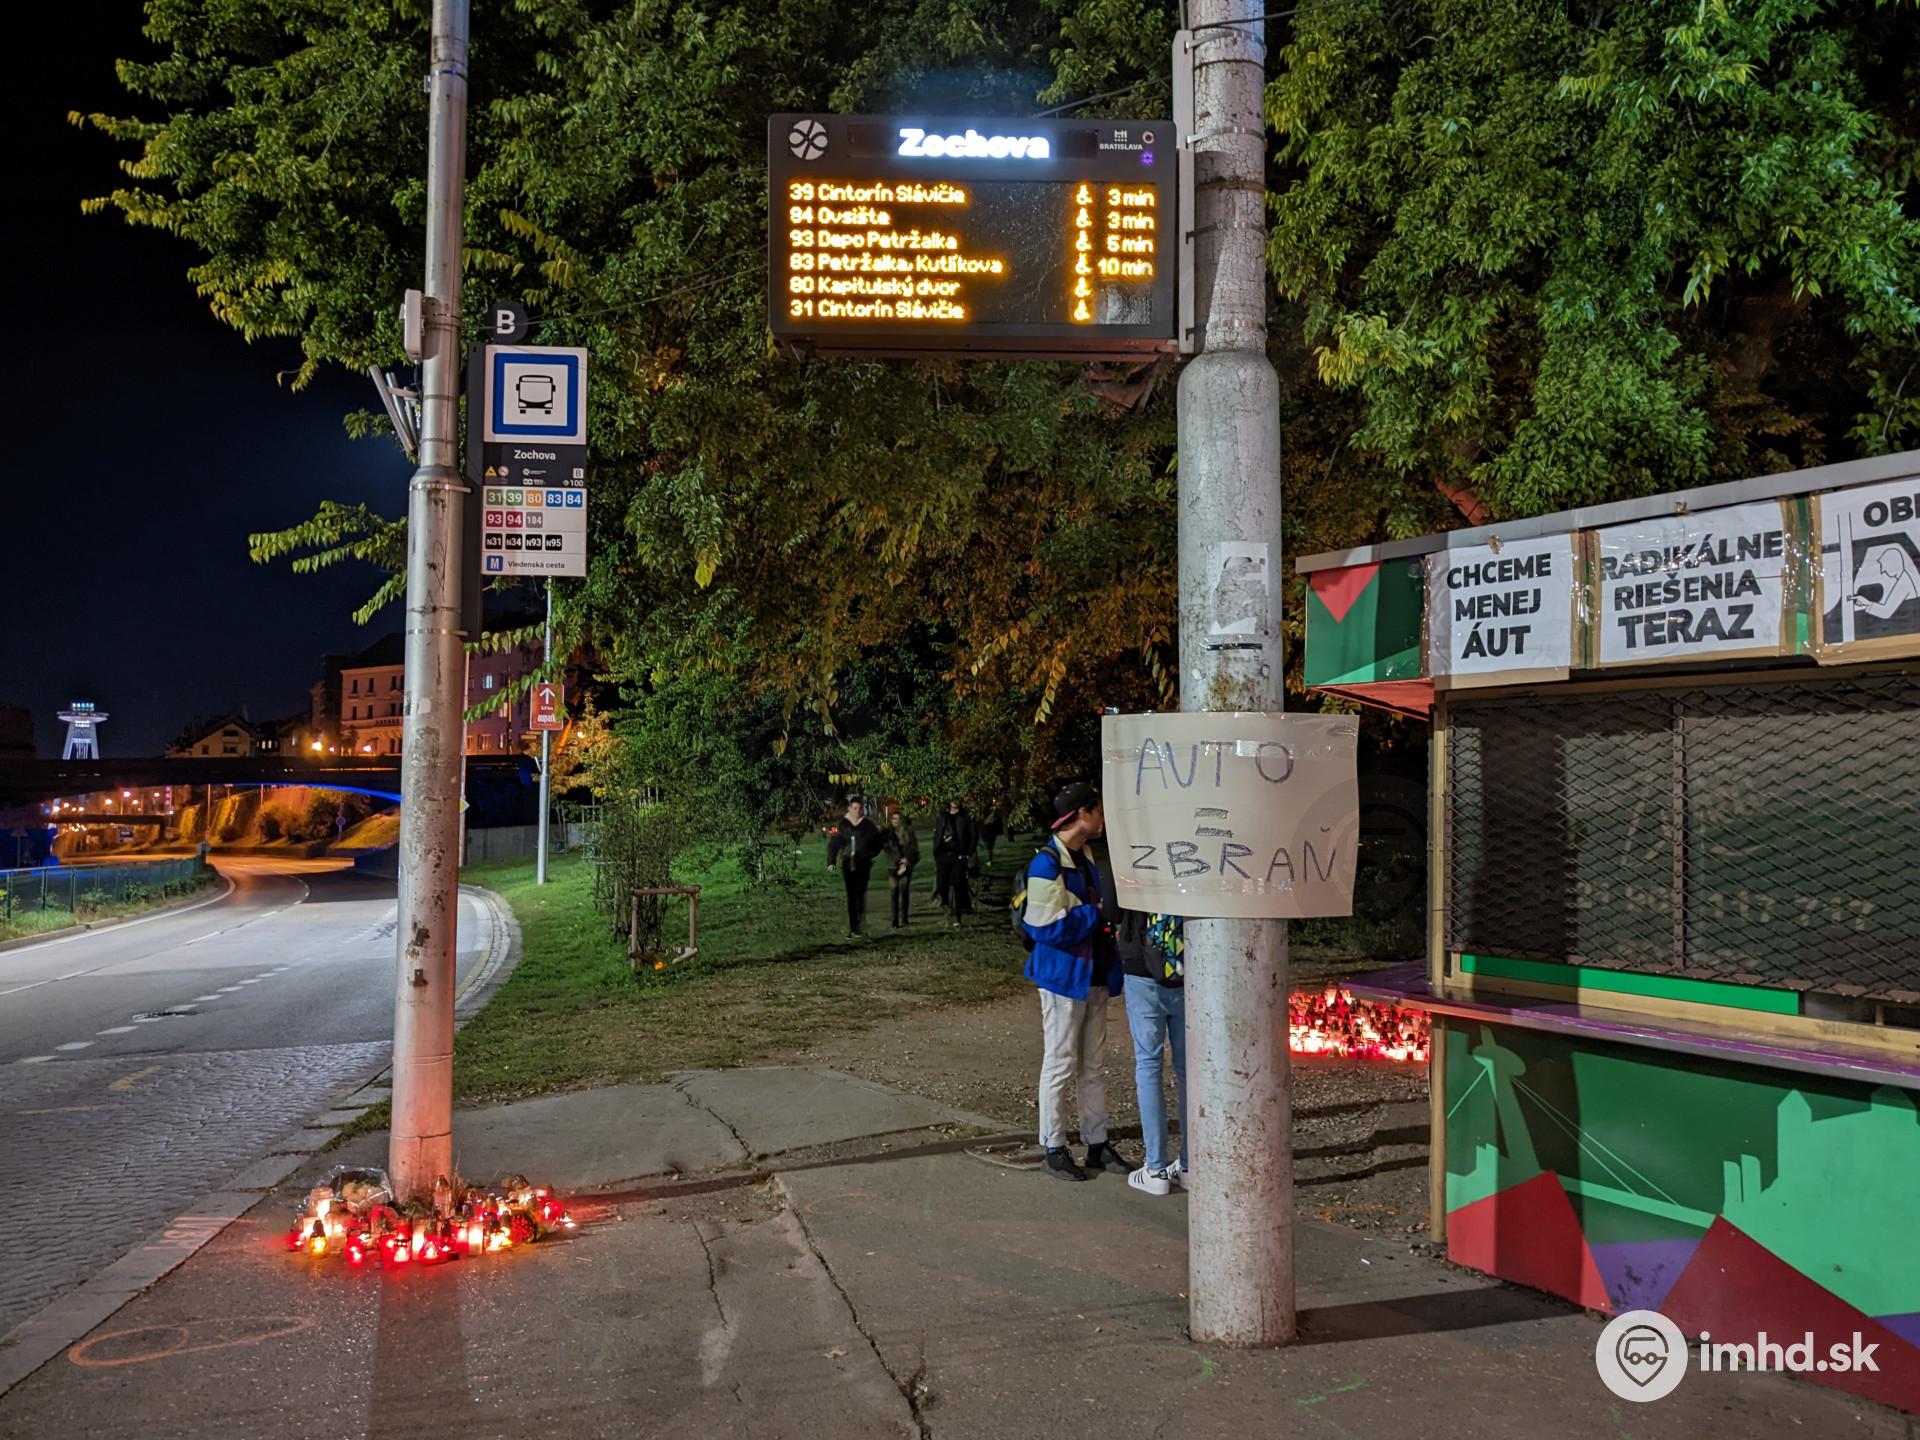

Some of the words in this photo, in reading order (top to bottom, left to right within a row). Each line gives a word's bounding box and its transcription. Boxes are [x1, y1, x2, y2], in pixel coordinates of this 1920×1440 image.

[899, 128, 1050, 158] Zochova
[789, 183, 814, 201] 39
[818, 183, 893, 202] Cintorín
[1108, 188, 1121, 206] 3
[1122, 189, 1155, 207] min
[789, 206, 814, 225] 84
[818, 205, 890, 226] Ovsište
[1107, 210, 1120, 230] 3
[1122, 212, 1155, 230] min
[789, 229, 814, 248] 93
[818, 230, 866, 250] Depo
[867, 229, 958, 250] Petržalka
[1121, 235, 1154, 253] min
[789, 253, 814, 271] 83
[1098, 257, 1120, 275] 10
[1121, 259, 1153, 276] min
[789, 276, 814, 294] 80
[818, 275, 913, 297] Kapitulský
[916, 277, 961, 296] dvor
[789, 299, 814, 317] 31
[818, 299, 894, 318] Cintorín
[496, 309, 516, 335] B
[514, 449, 556, 460] Zochova
[487, 492, 502, 503] 31
[507, 492, 522, 503] 39
[527, 494, 542, 504] 80
[547, 494, 562, 504] 83
[566, 495, 581, 505] 84
[1863, 492, 1920, 527] OB
[487, 514, 502, 524] 93
[507, 514, 522, 525] 94
[527, 515, 542, 524] 184
[487, 537, 501, 546] N31
[506, 537, 521, 546] N34
[526, 538, 541, 547] N93
[546, 539, 561, 548] N95
[490, 557, 500, 569] M
[1600, 530, 1784, 582] RADIKÁLNE
[1446, 553, 1552, 590] CHCEME
[1614, 569, 1762, 612] RIEŠENIA
[1455, 588, 1542, 621] MENEJ
[1617, 603, 1755, 649] TERAZ
[1461, 622, 1532, 659] ÁUT
[1136, 737, 1294, 796] AUTO
[1130, 825, 1336, 884] ZBRAŇ
